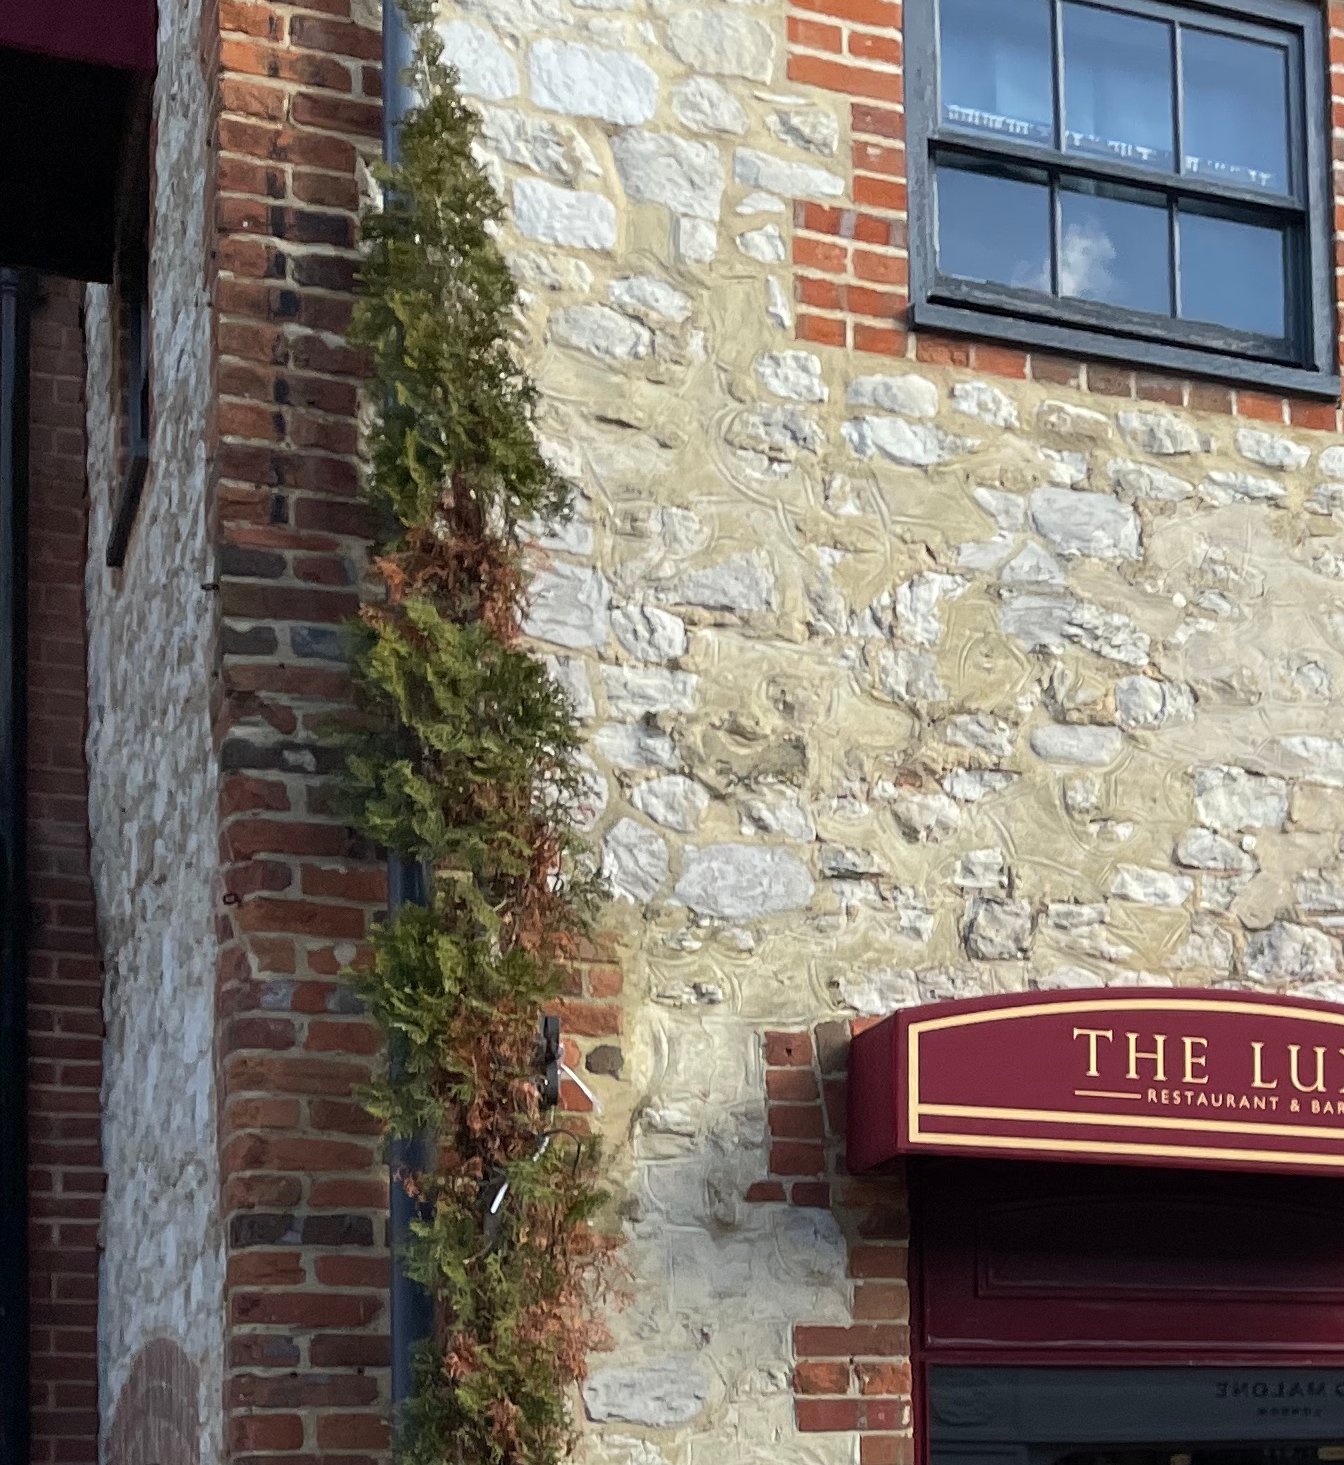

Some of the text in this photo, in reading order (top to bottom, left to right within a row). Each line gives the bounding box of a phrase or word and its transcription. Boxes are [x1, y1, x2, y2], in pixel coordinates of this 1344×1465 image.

[1074, 1027, 1209, 1084] THE
[1147, 1088, 1279, 1111] RESTAURANT
[1289, 1099, 1301, 1113] &
